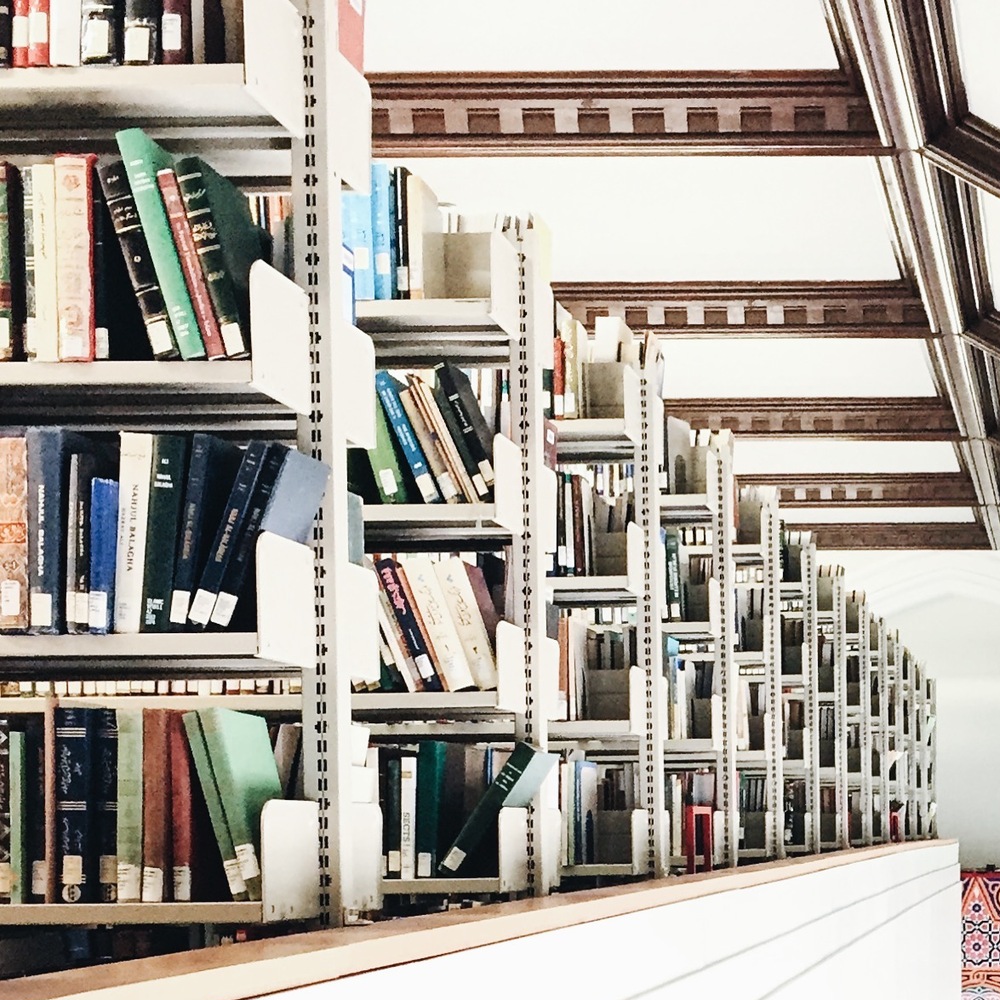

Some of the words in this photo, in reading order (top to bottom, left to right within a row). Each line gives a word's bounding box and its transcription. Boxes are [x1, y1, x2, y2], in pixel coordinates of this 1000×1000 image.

[37, 484, 45, 521] NAHJUL
[131, 484, 139, 523] NAHJUL
[37, 528, 45, 577] BALAGHA
[126, 526, 137, 572] BALAGHA
